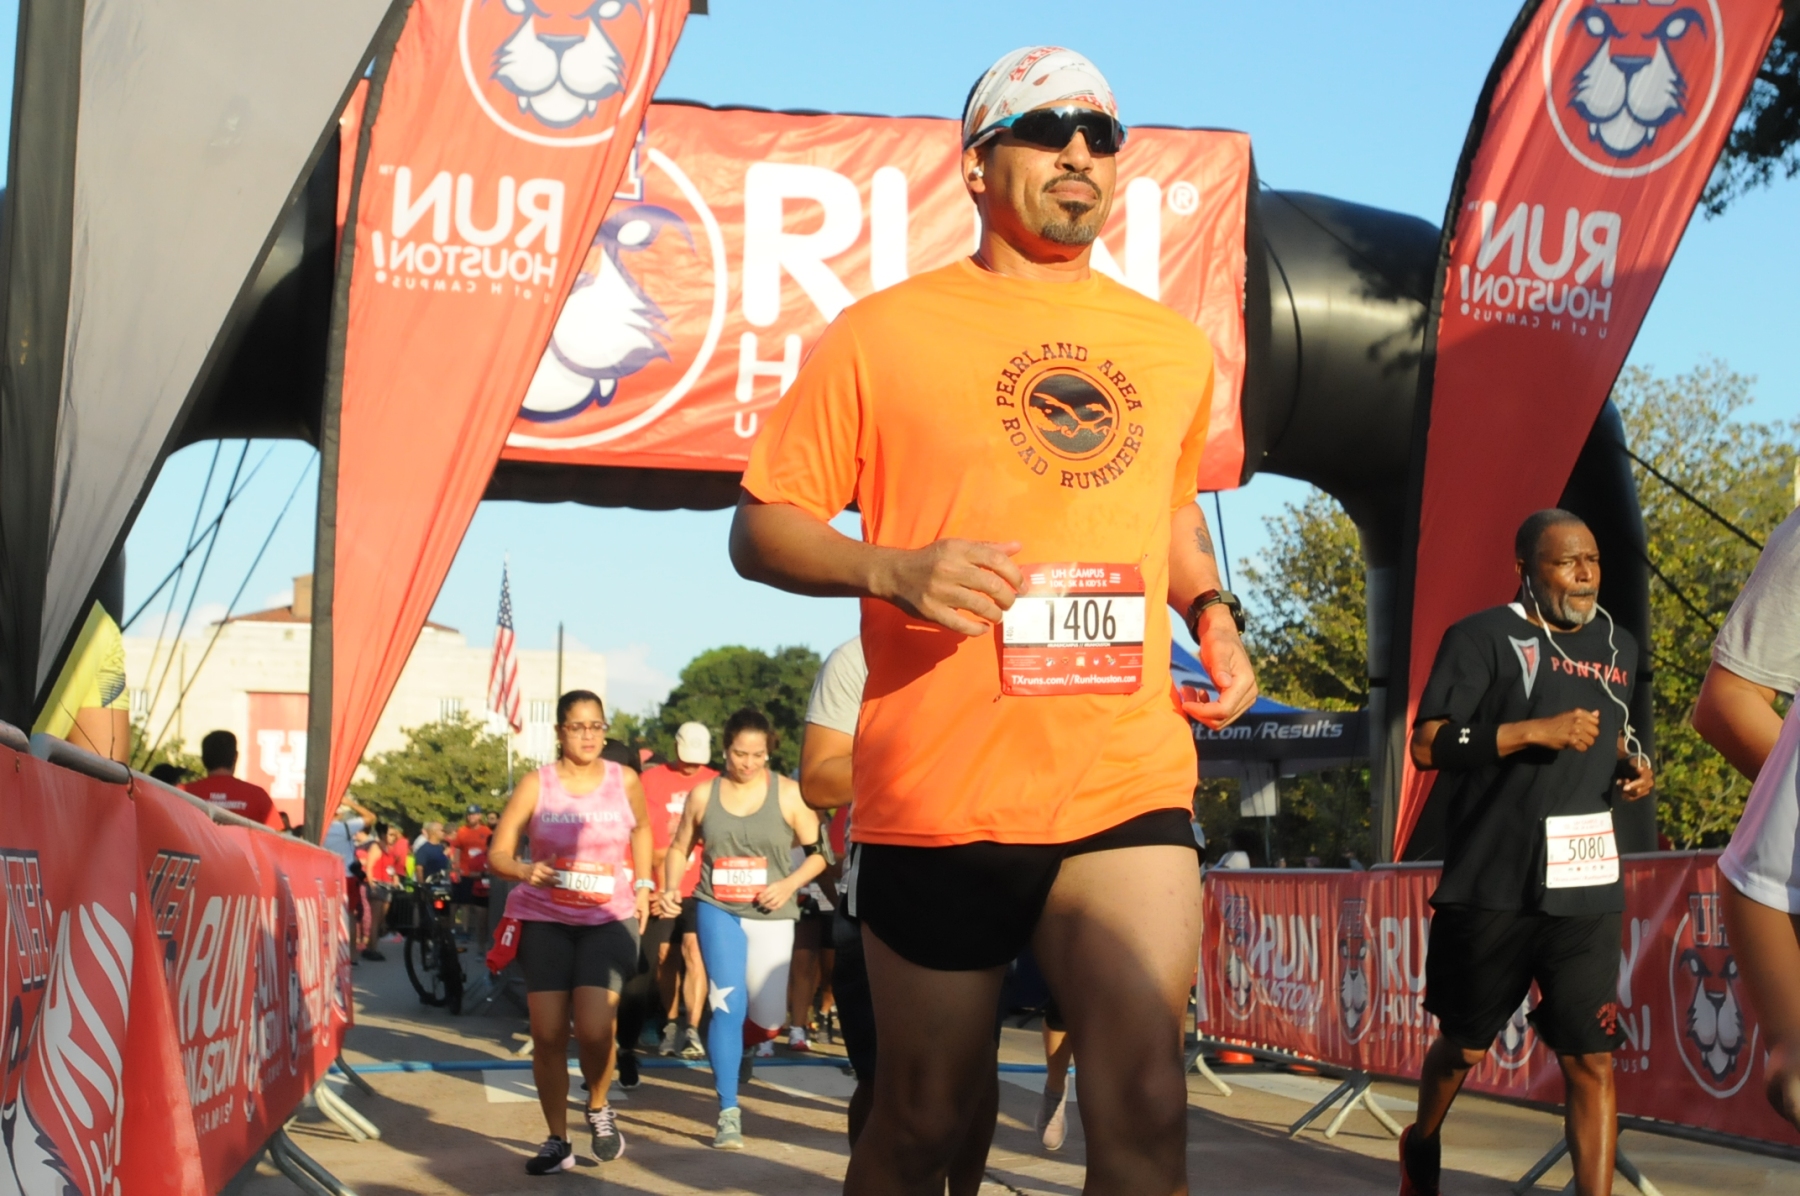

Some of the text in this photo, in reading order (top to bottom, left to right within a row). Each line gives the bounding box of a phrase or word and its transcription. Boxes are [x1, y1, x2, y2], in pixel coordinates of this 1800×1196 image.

[997, 342, 1143, 411] PEARLAND AREA
[1002, 417, 1144, 489] ROAD RUNNERS
[1051, 567, 1105, 579] UH CAMPUS
[1046, 599, 1116, 641] 1406
[541, 811, 621, 823] GRATITUDE
[1568, 836, 1605, 861] 5080
[567, 872, 599, 891] 1607
[726, 870, 753, 884] 1605
[1250, 914, 1318, 982] RUN
[1380, 916, 1431, 993] RU
[179, 895, 257, 1045] RUN
